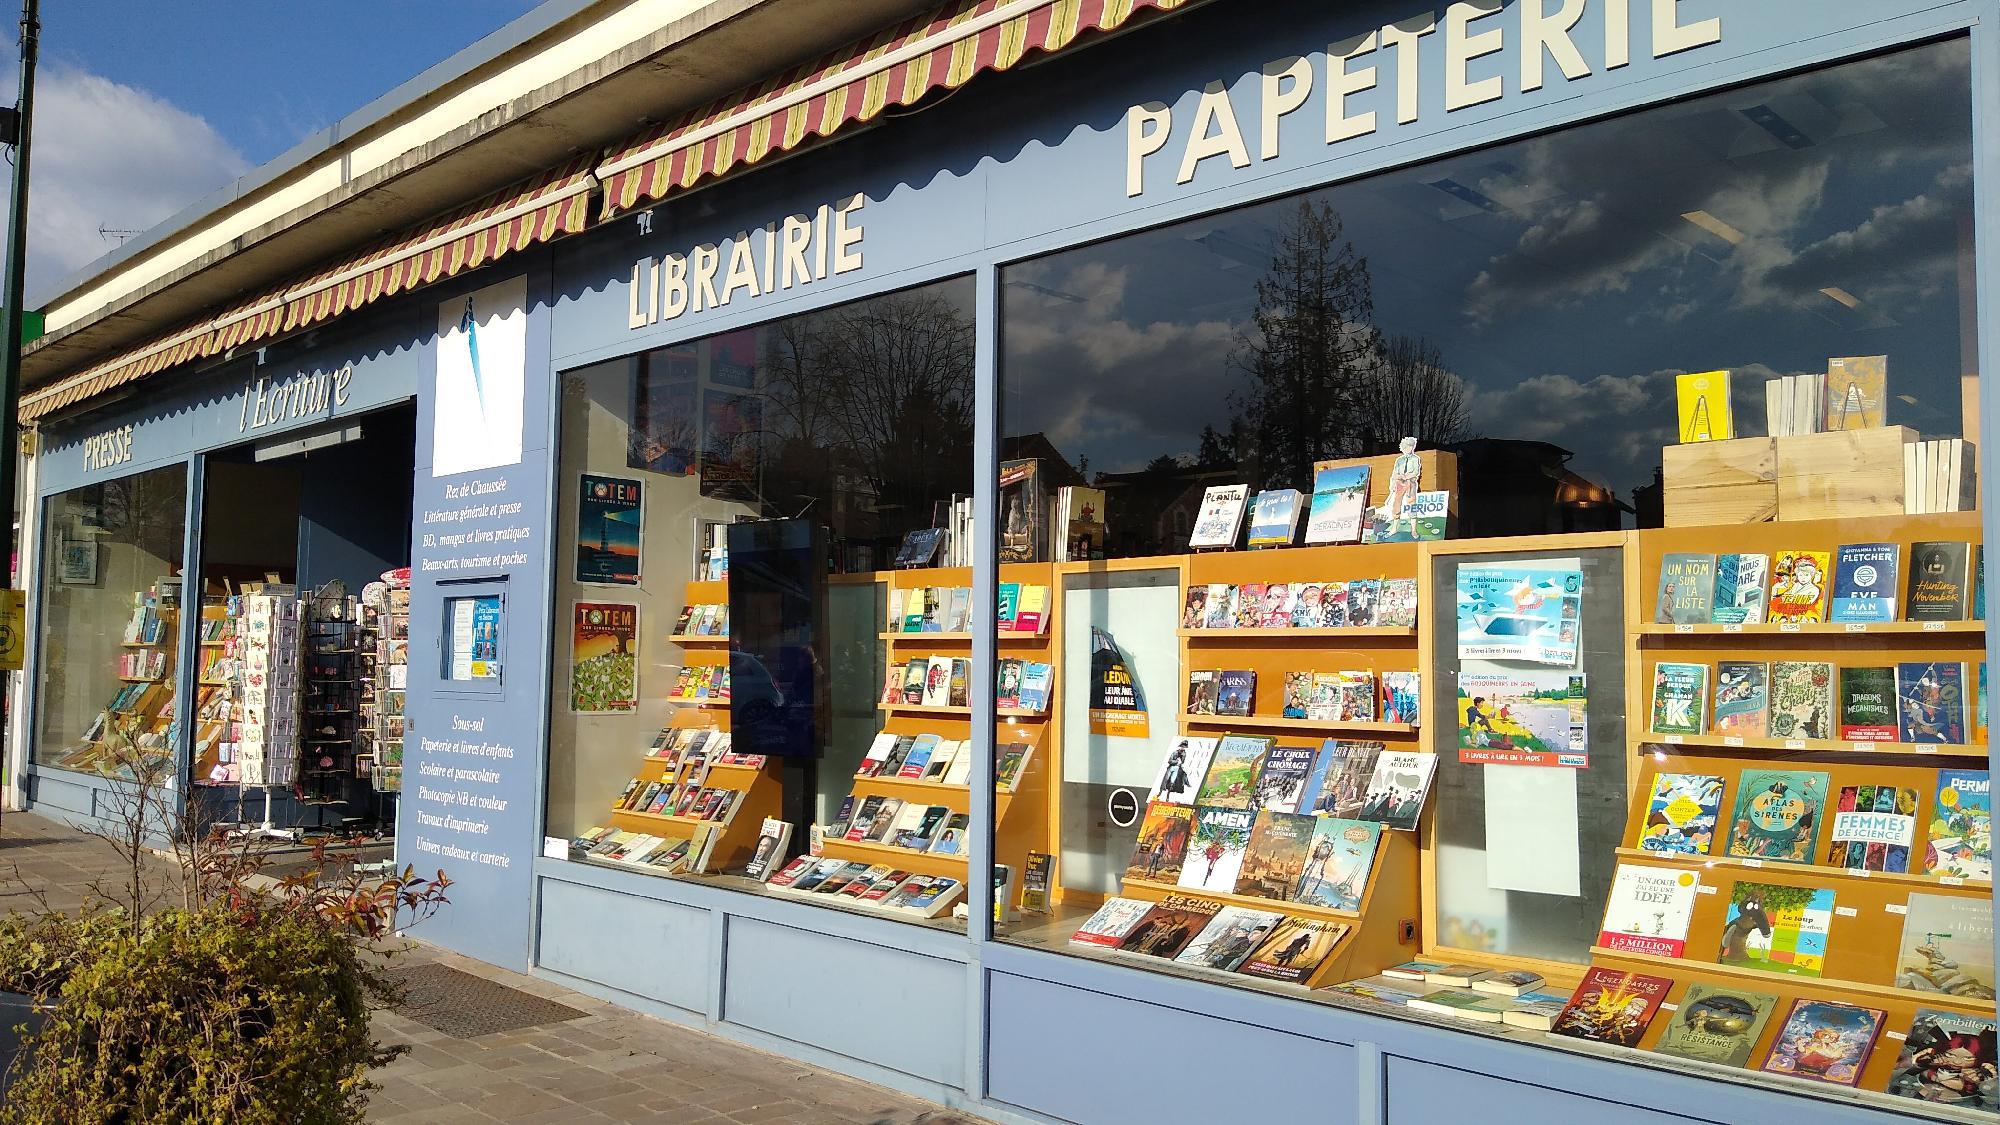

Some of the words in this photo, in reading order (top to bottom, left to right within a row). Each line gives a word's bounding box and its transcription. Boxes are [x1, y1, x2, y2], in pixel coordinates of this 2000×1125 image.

[629, 192, 864, 330] LIBRAIRIE
[84, 424, 133, 472] PRESSE
[446, 484, 459, 499] Rez
[460, 483, 469, 496] de
[471, 477, 506, 495] Chaussée
[1418, 494, 1445, 503] BLUE
[424, 509, 459, 523] Littérature
[460, 504, 489, 522] générale
[490, 504, 497, 515] et
[498, 502, 521, 518] presse
[1403, 503, 1444, 515] PERIOD
[439, 534, 465, 547] mangas
[466, 531, 474, 542] et
[475, 528, 493, 542] livres
[495, 525, 530, 543] pratiques
[460, 554, 491, 568] tourisme
[492, 555, 500, 566] et
[500, 551, 528, 568] poches
[1842, 553, 1893, 562] FLETCHER
[1668, 564, 1681, 576] UN
[1685, 563, 1709, 576] NOM
[1679, 576, 1696, 586] SUR
[1916, 581, 1958, 594] Hunting
[1687, 587, 1698, 597] LA
[1676, 598, 1705, 609] LISTE
[1847, 602, 1876, 611] MAN
[1852, 694, 1881, 703] DRAGONS
[1666, 699, 1692, 727] K
[452, 715, 485, 732] Sous-sol
[421, 737, 451, 754] Papeterie
[453, 741, 461, 753] et
[461, 741, 479, 756] livres
[480, 742, 514, 760] d'enfants
[1272, 750, 1283, 758] LE
[1284, 751, 1311, 759] CHOIX
[420, 761, 446, 777] Scolaire
[447, 766, 455, 778] et
[454, 768, 500, 784] parascolaire
[419, 786, 456, 806] Photocopie
[457, 790, 469, 806] NB
[470, 793, 478, 807] et
[478, 795, 508, 811] couleur
[1762, 798, 1795, 807] ATLAS
[417, 810, 443, 828] Travaux
[444, 814, 489, 835] d'imprimerie
[1202, 811, 1251, 827] AMEN
[1839, 815, 1906, 832] FEMMES
[1838, 829, 1851, 837] DE
[416, 836, 441, 855] Univers
[441, 844, 470, 862] cadeaux
[470, 851, 478, 862] et
[479, 852, 510, 868] carterie
[1652, 878, 1676, 886] JOUR
[1164, 895, 1184, 905] LES
[1187, 898, 1220, 911] CINQ
[1170, 904, 1216, 915] CAMBRIDGE
[1782, 913, 1792, 922] Le
[1795, 915, 1814, 925] loup
[1610, 937, 1625, 945] 1,5
[1626, 939, 1674, 952] MILLION
